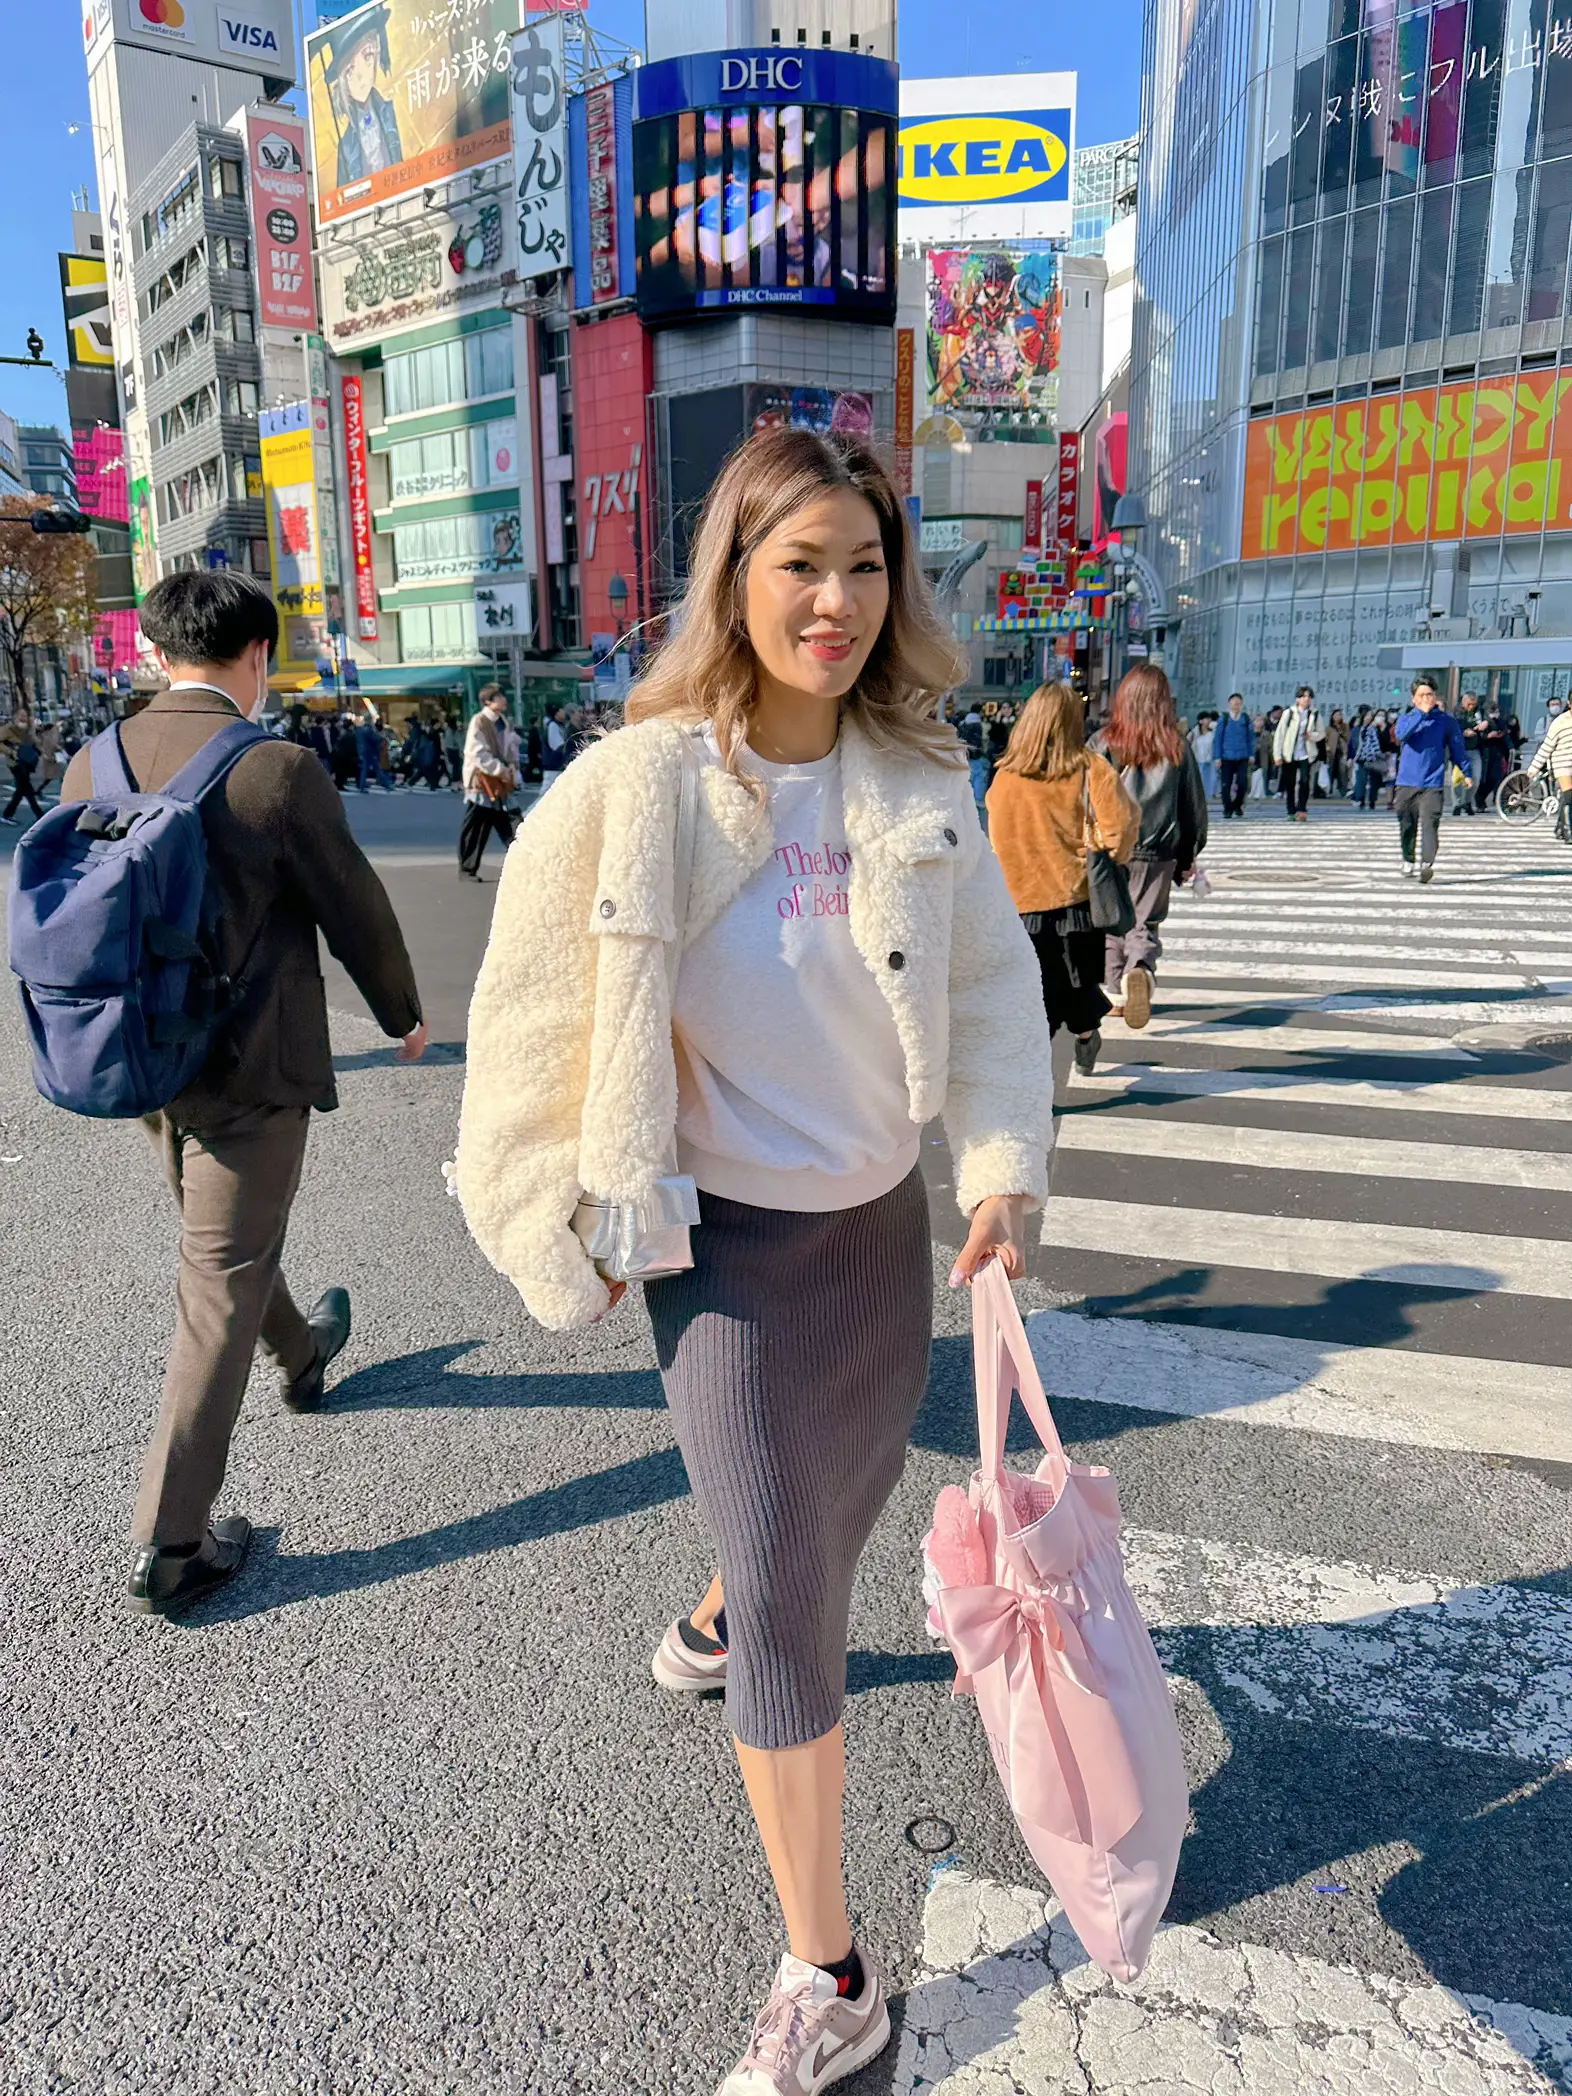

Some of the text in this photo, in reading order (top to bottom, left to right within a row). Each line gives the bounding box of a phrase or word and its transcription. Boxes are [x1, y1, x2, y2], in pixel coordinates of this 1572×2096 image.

[221, 19, 278, 51] VISA
[404, 30, 511, 115] 雨が来る
[721, 57, 802, 91] DHC
[513, 30, 565, 264] もんじゃ
[728, 289, 802, 303] DHC Channel
[1265, 378, 1572, 485] VAUNDY
[584, 442, 642, 560] クスリ
[1261, 458, 1563, 552] replica
[774, 842, 822, 877] The
[777, 882, 804, 919] of
